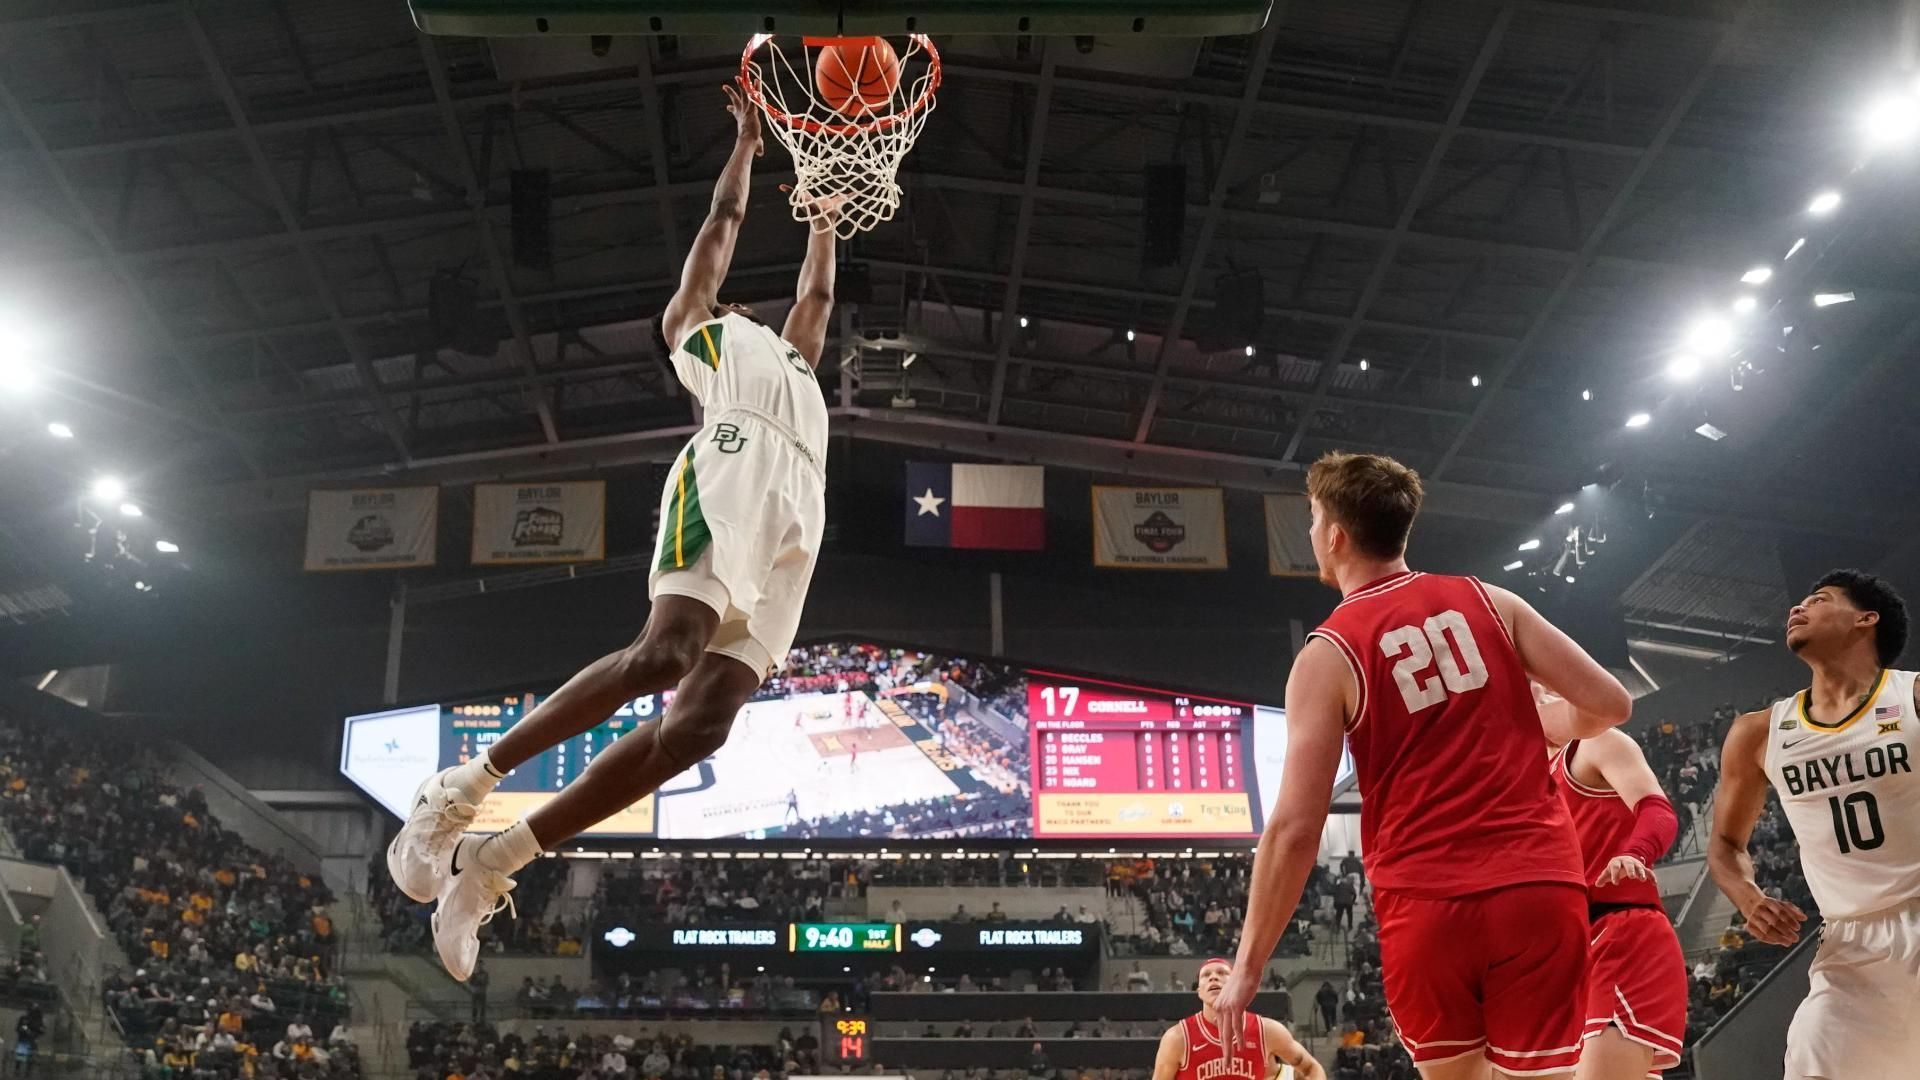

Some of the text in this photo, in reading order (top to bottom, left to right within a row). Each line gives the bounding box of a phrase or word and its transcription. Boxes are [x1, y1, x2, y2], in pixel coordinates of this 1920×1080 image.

[710, 423, 748, 454] BU
[1135, 492, 1179, 505] BAYLOR
[1379, 609, 1489, 714] 20
[1041, 687, 1148, 716] 17 CORNELL
[1782, 742, 1912, 796] BAYLOR
[1828, 791, 1885, 854] 10
[673, 930, 776, 945] FLAT ROCK TRAILERS
[805, 927, 853, 948] 9:40
[862, 940, 891, 948] HALF
[867, 929, 887, 939] 1ST
[980, 930, 1082, 945] FLAT ROCK TRAILERS
[837, 1021, 866, 1035] 9:39
[842, 1037, 862, 1058] 14
[1196, 1056, 1256, 1080] CORNELL
